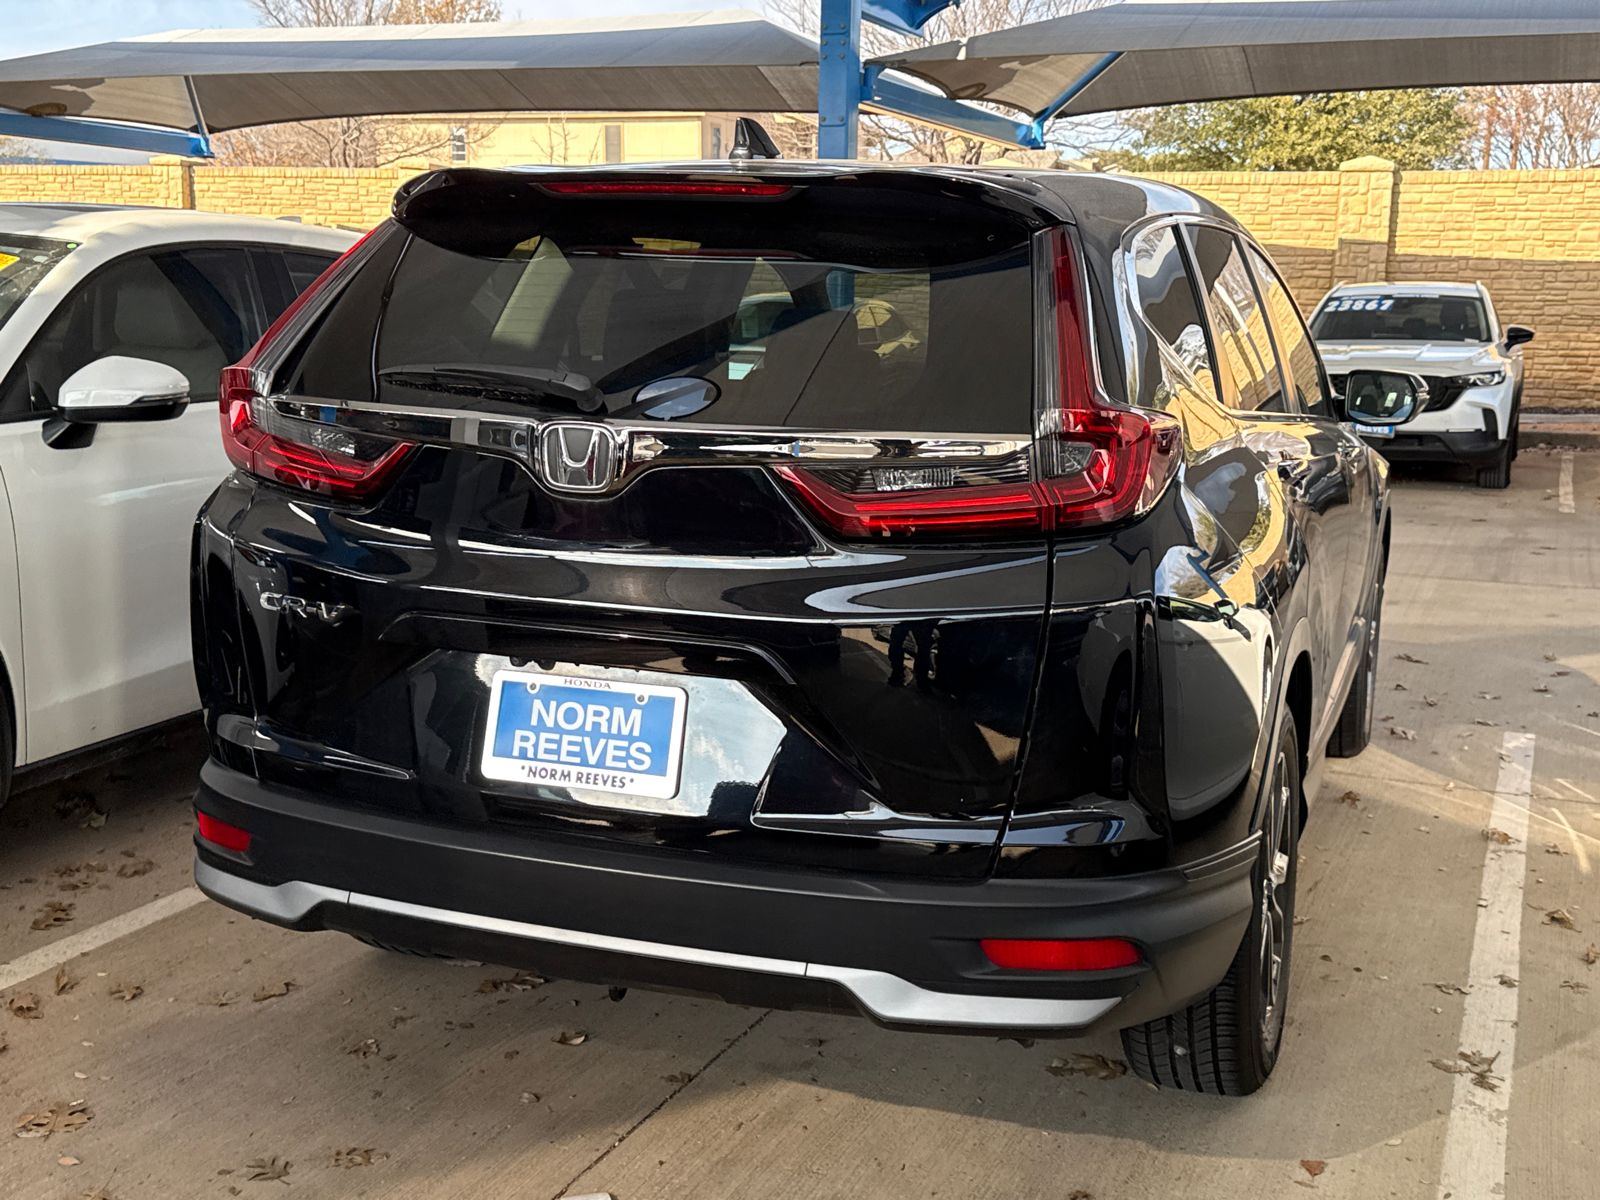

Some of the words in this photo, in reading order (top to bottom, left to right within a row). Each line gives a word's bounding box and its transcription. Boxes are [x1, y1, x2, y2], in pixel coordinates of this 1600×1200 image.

[563, 678, 612, 690] HONDA
[530, 699, 643, 737] NORM
[512, 729, 652, 771] REEVES
[527, 765, 571, 783] NORM
[575, 771, 626, 788] REEVES
